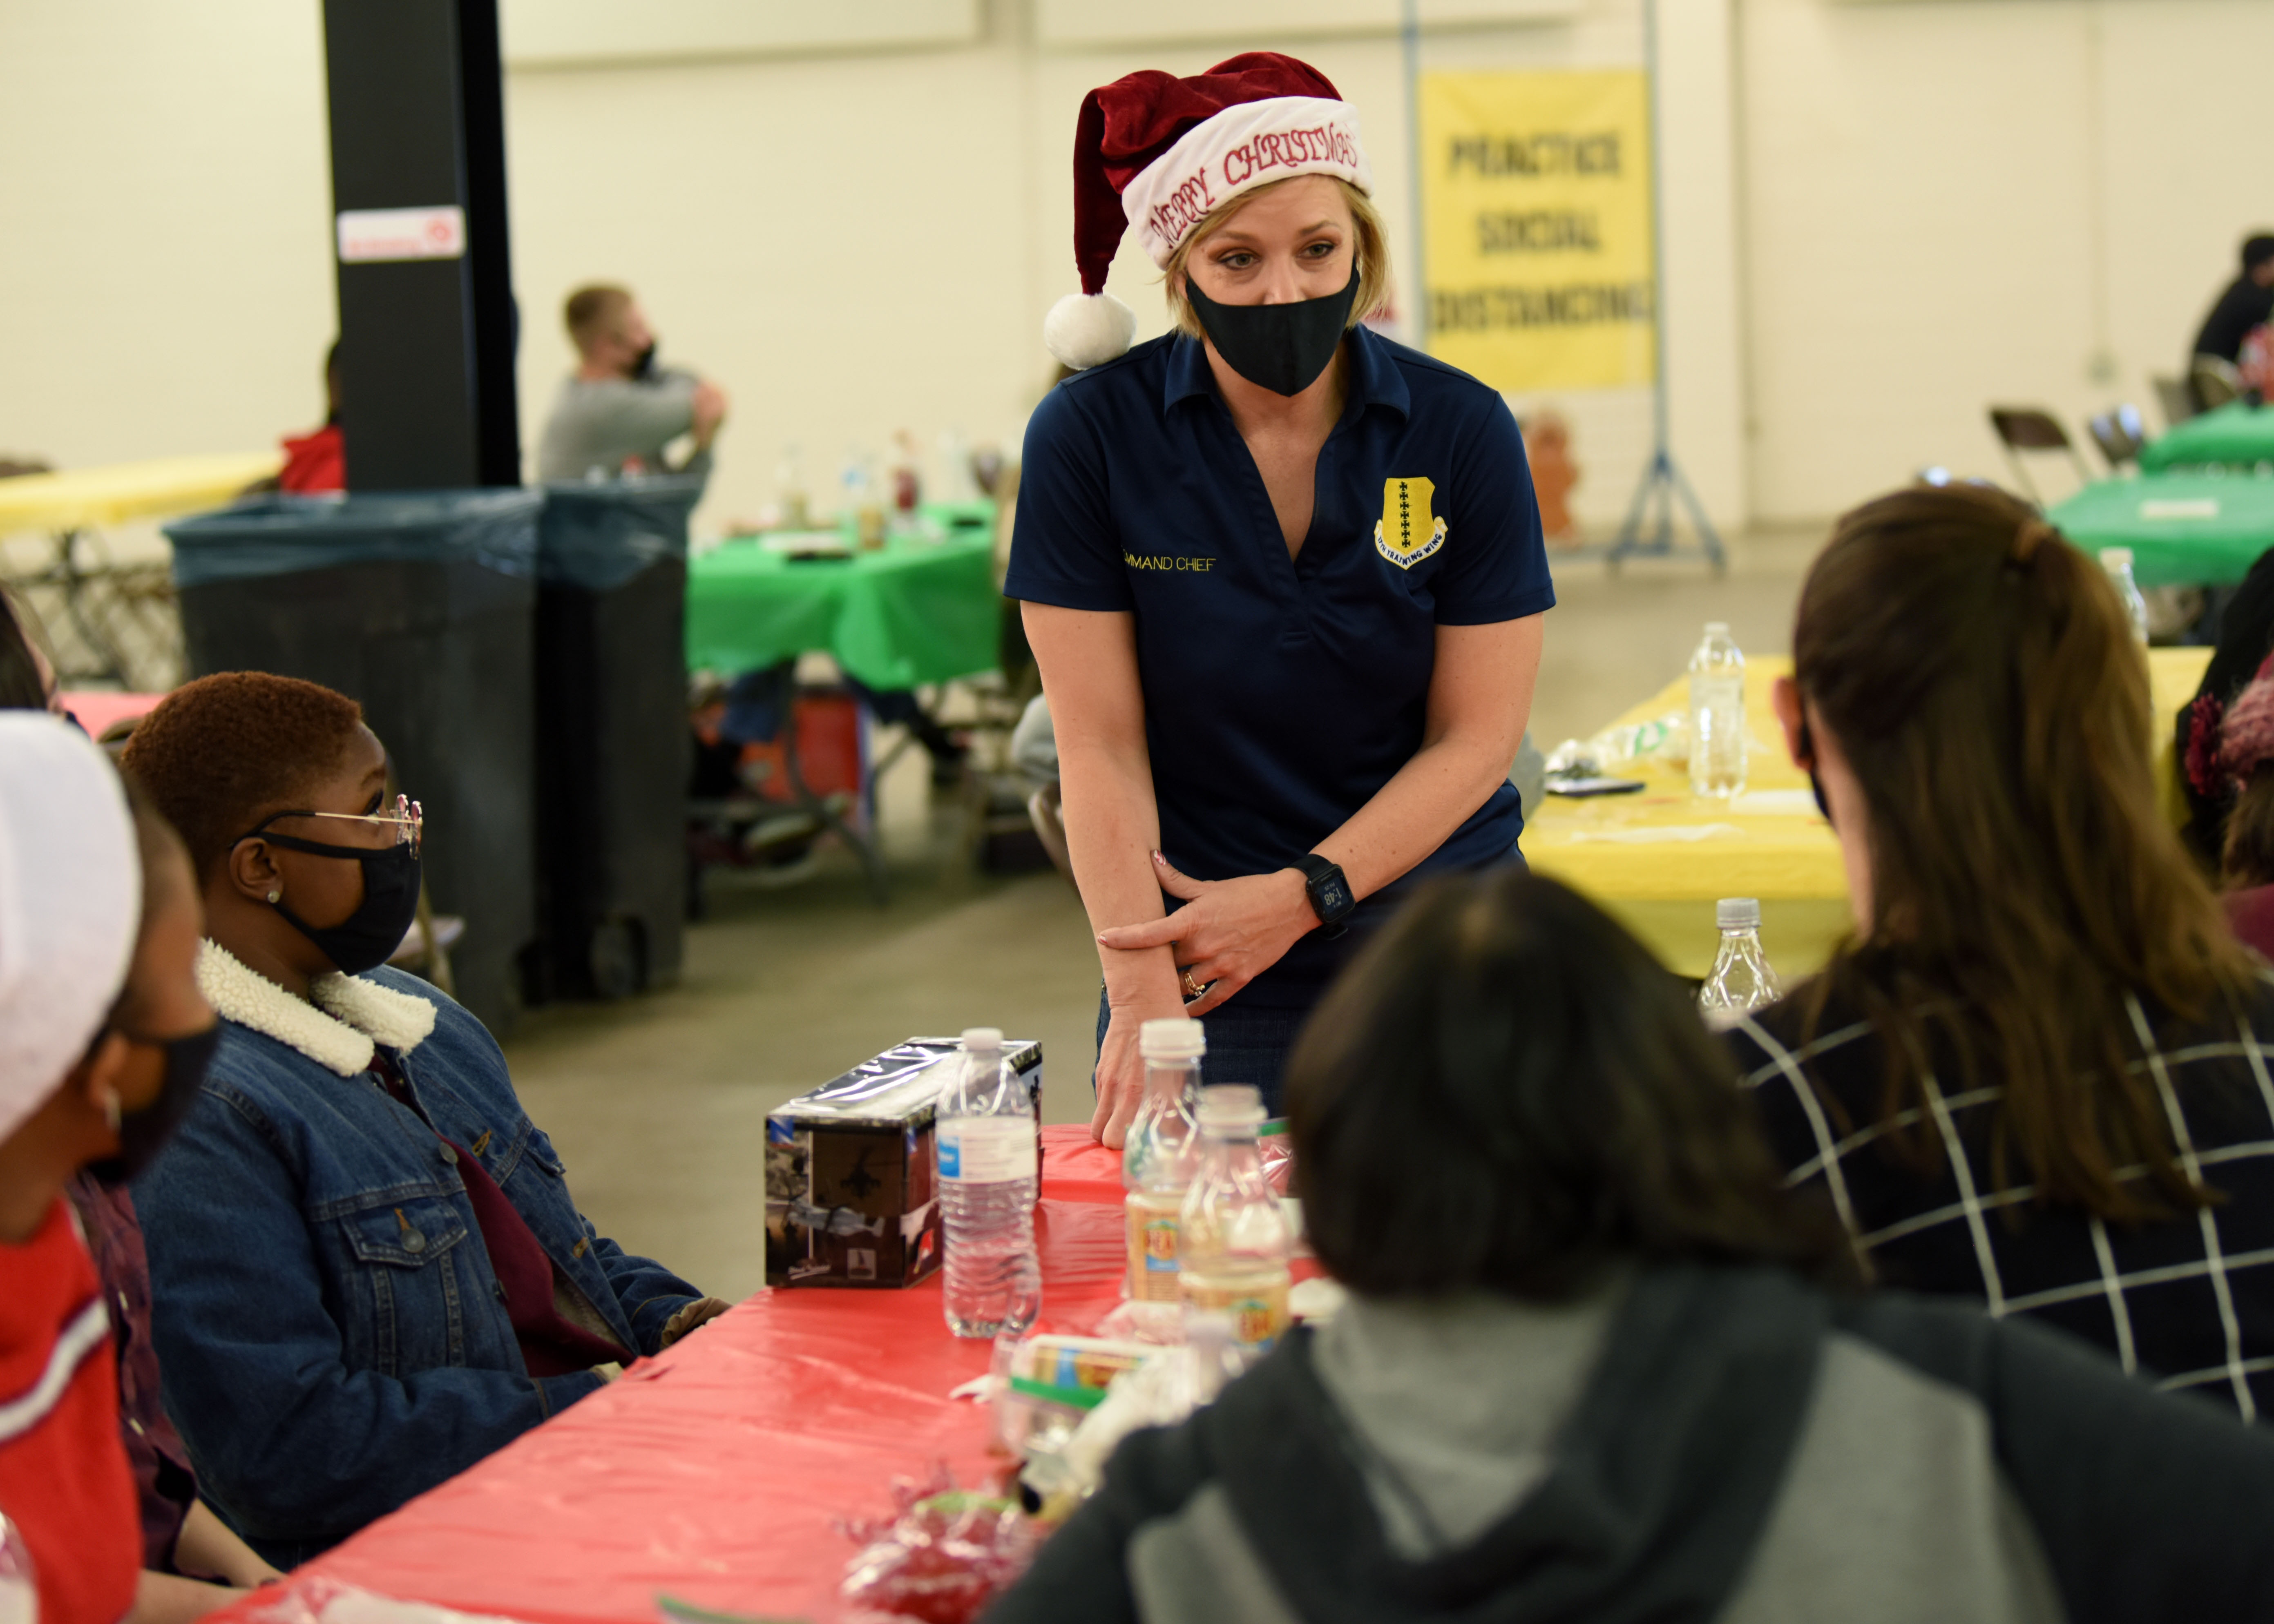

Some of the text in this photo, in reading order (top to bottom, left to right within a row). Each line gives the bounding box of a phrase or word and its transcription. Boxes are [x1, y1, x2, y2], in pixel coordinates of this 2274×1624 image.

[1150, 121, 1357, 249] MERRY CHRISTMAS
[1476, 208, 1599, 254] SOCIAL
[1124, 550, 1216, 571] MMAND CHIEF
[1387, 550, 1423, 565] TRAINING
[1423, 534, 1442, 553] WING
[1324, 887, 1342, 905] 1:48
